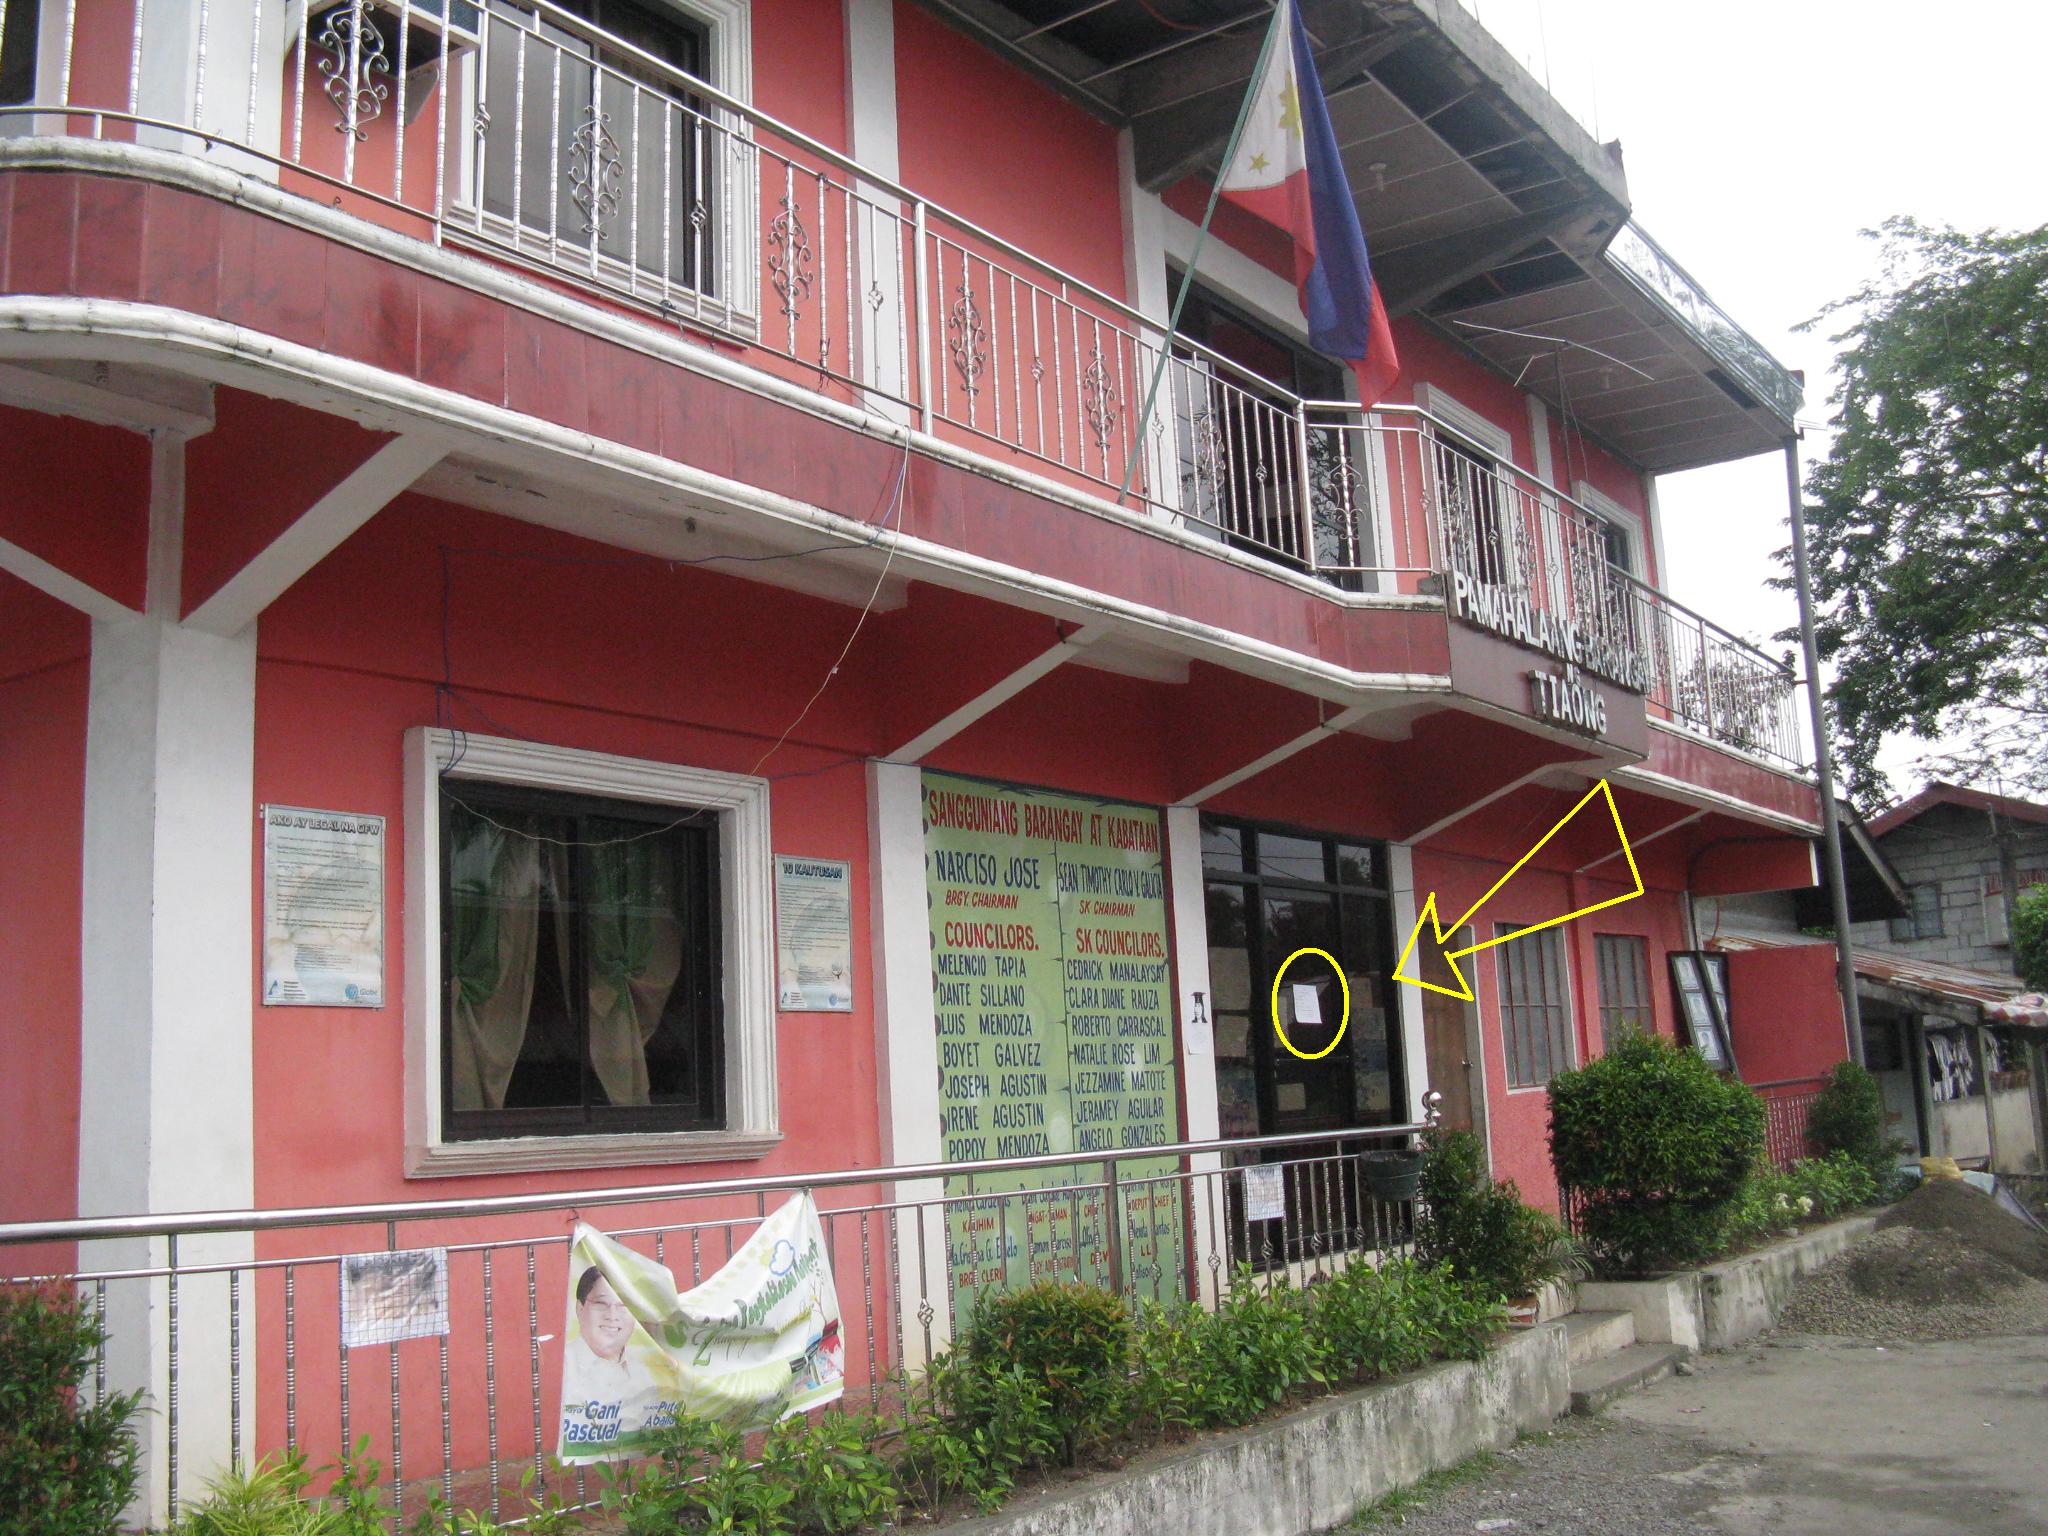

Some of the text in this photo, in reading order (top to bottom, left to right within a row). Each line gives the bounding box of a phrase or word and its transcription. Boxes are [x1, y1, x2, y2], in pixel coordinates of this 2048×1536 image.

[1531, 669, 1607, 734] TIAONG
[929, 789, 1159, 853] SANGGUNIANG BARANGAY AT KABATAAN
[935, 850, 1040, 890] NARCISO JOSE
[1058, 862, 1079, 893] SEAN
[1080, 864, 1113, 895] TIMOTHY
[945, 889, 1018, 910] BRGY. CHAIRMAN
[1079, 900, 1136, 917] SK CHAIRMAN
[945, 921, 1039, 952] COUNCILORS.
[1076, 928, 1165, 958] SK COUNCILORS.
[938, 954, 1026, 978] MELENCIO TAPIA
[1067, 960, 1165, 984] CEDRICK MANALAYSAY
[939, 983, 1025, 1008] DANTE SILLANO
[1069, 988, 1159, 1010] CLARA DIANE RAUZA
[941, 1013, 1032, 1036] LUIS MENDOZA
[1072, 1015, 1166, 1037] ROBERTO CARRASCAL
[943, 1042, 1041, 1068] BOYET GALVEZ
[1073, 1043, 1160, 1066] NATALIE ROSE LIM
[945, 1074, 1047, 1099] JOSEPH AGUSTIN
[1074, 1071, 1166, 1094] JEZZAMINE MATOTE
[946, 1103, 1044, 1132] IRENE AGUSTIN
[1076, 1097, 1164, 1124] JERAMEY AGUILAR
[949, 1133, 1050, 1161] POPOY MENDOZA
[1079, 1124, 1166, 1151] ANGELO GONZALES
[584, 1399, 622, 1420] Gani
[563, 1418, 622, 1442] Pascual
